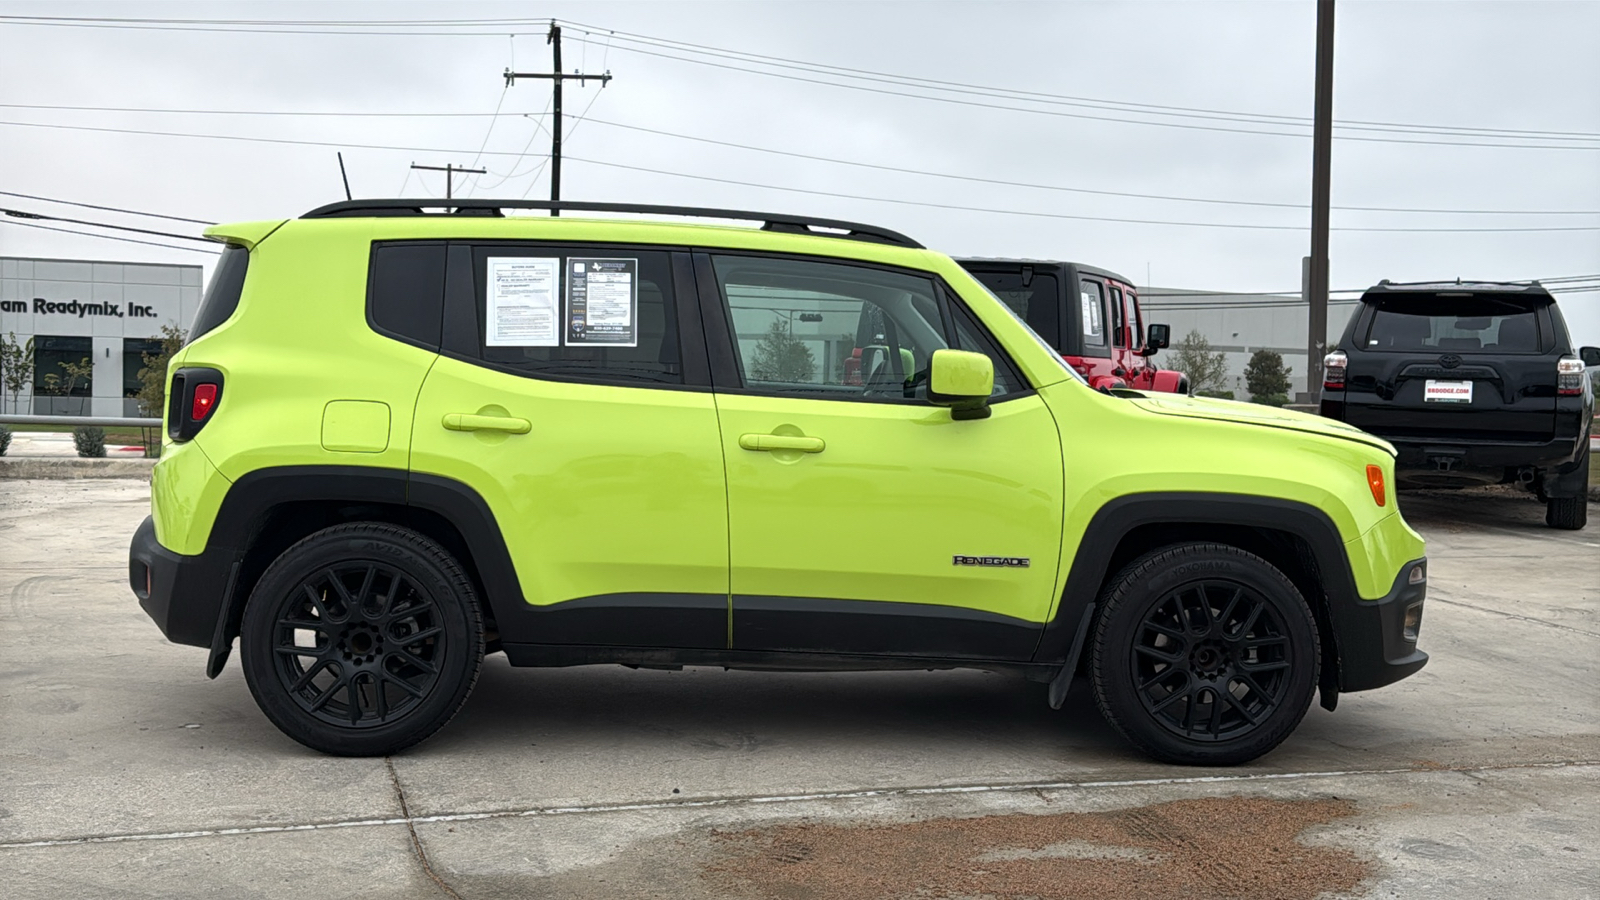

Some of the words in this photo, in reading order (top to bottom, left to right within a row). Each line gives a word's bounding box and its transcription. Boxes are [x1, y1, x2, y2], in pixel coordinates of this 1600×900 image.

[0, 300, 27, 313] am
[33, 298, 124, 318] Readymix,
[128, 302, 158, 318] Inc.
[952, 554, 1030, 568] RENEGADE
[1172, 562, 1232, 577] YOKOHAMA
